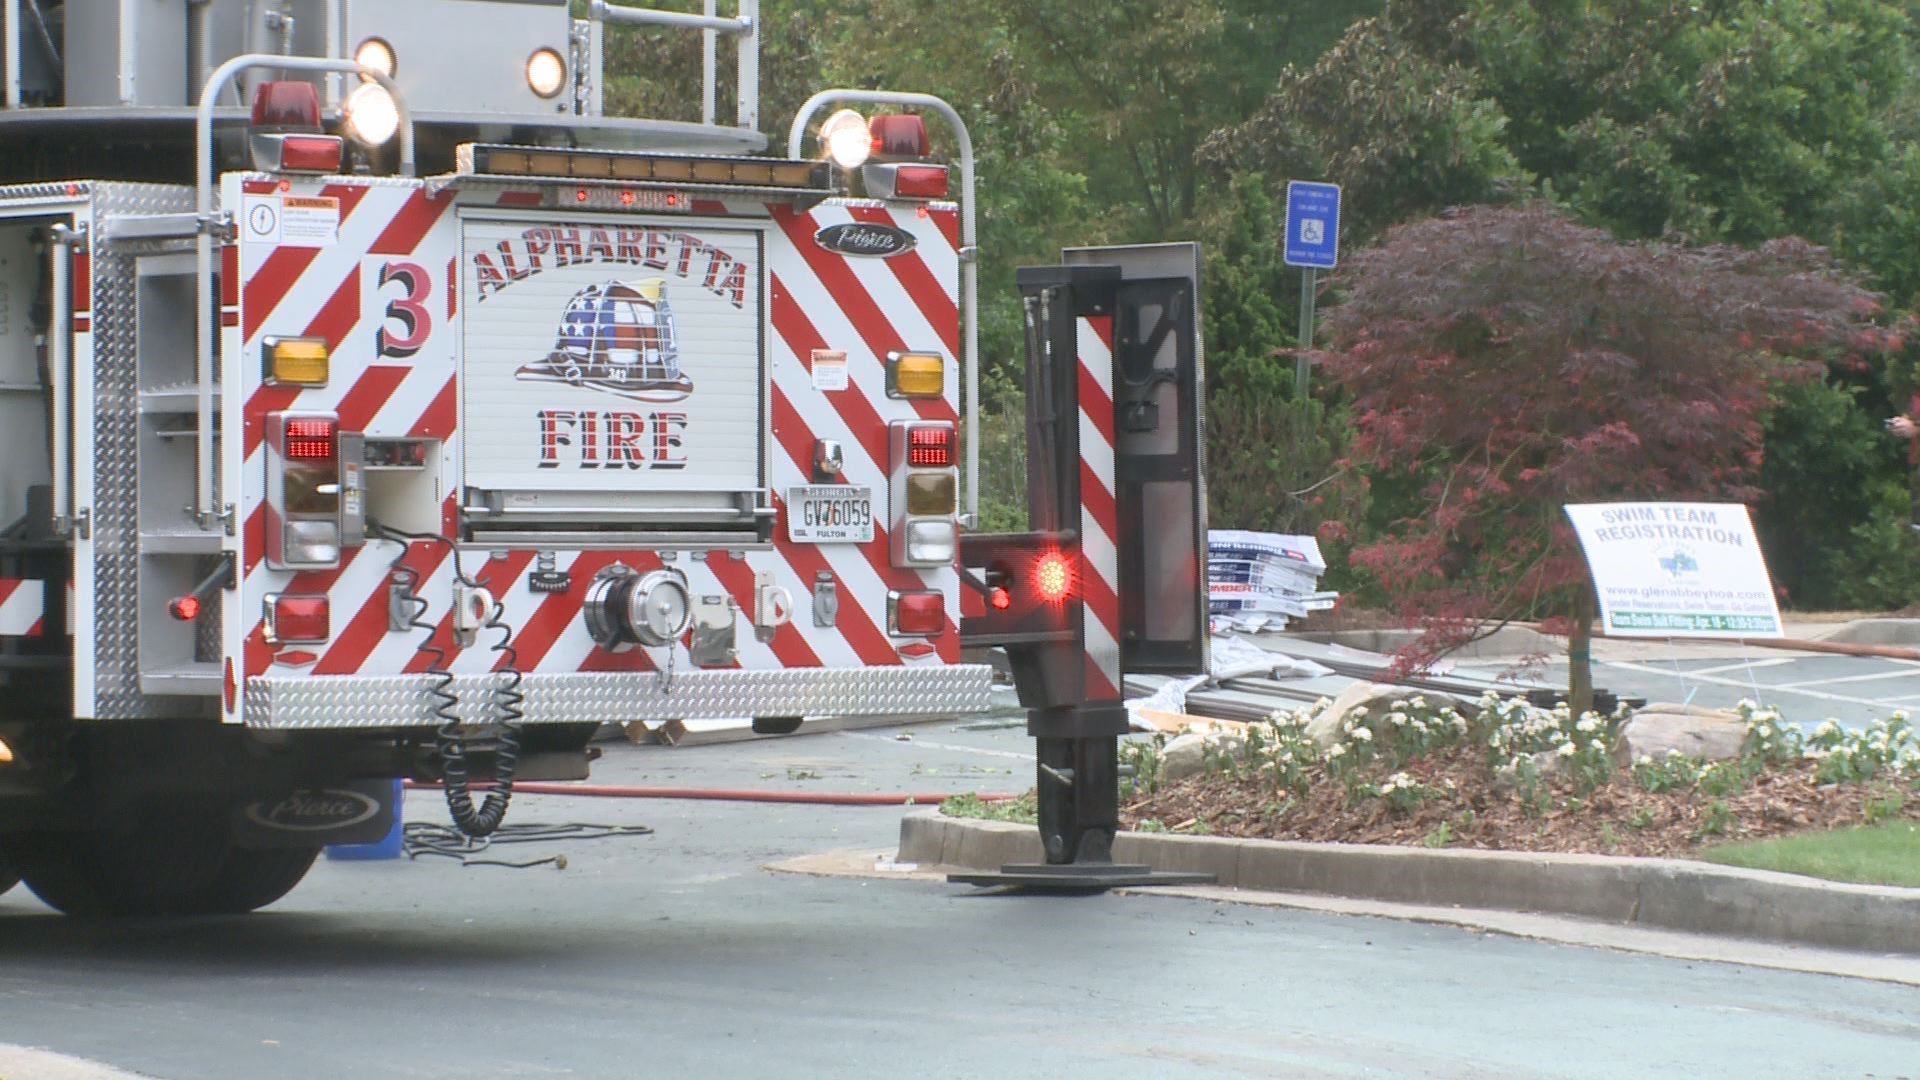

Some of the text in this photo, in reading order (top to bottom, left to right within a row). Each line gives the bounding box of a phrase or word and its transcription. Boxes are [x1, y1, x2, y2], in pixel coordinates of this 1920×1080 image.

[837, 226, 896, 249] Pierce
[474, 223, 747, 309] ALPHARETTA
[376, 262, 433, 359] 3
[608, 368, 627, 382] 343
[537, 411, 688, 470] FIRE
[804, 499, 870, 526] GV76059
[1601, 507, 1718, 525] SWIM TEAM
[816, 530, 847, 538] FULTON
[1595, 523, 1743, 547] REGISTRATION
